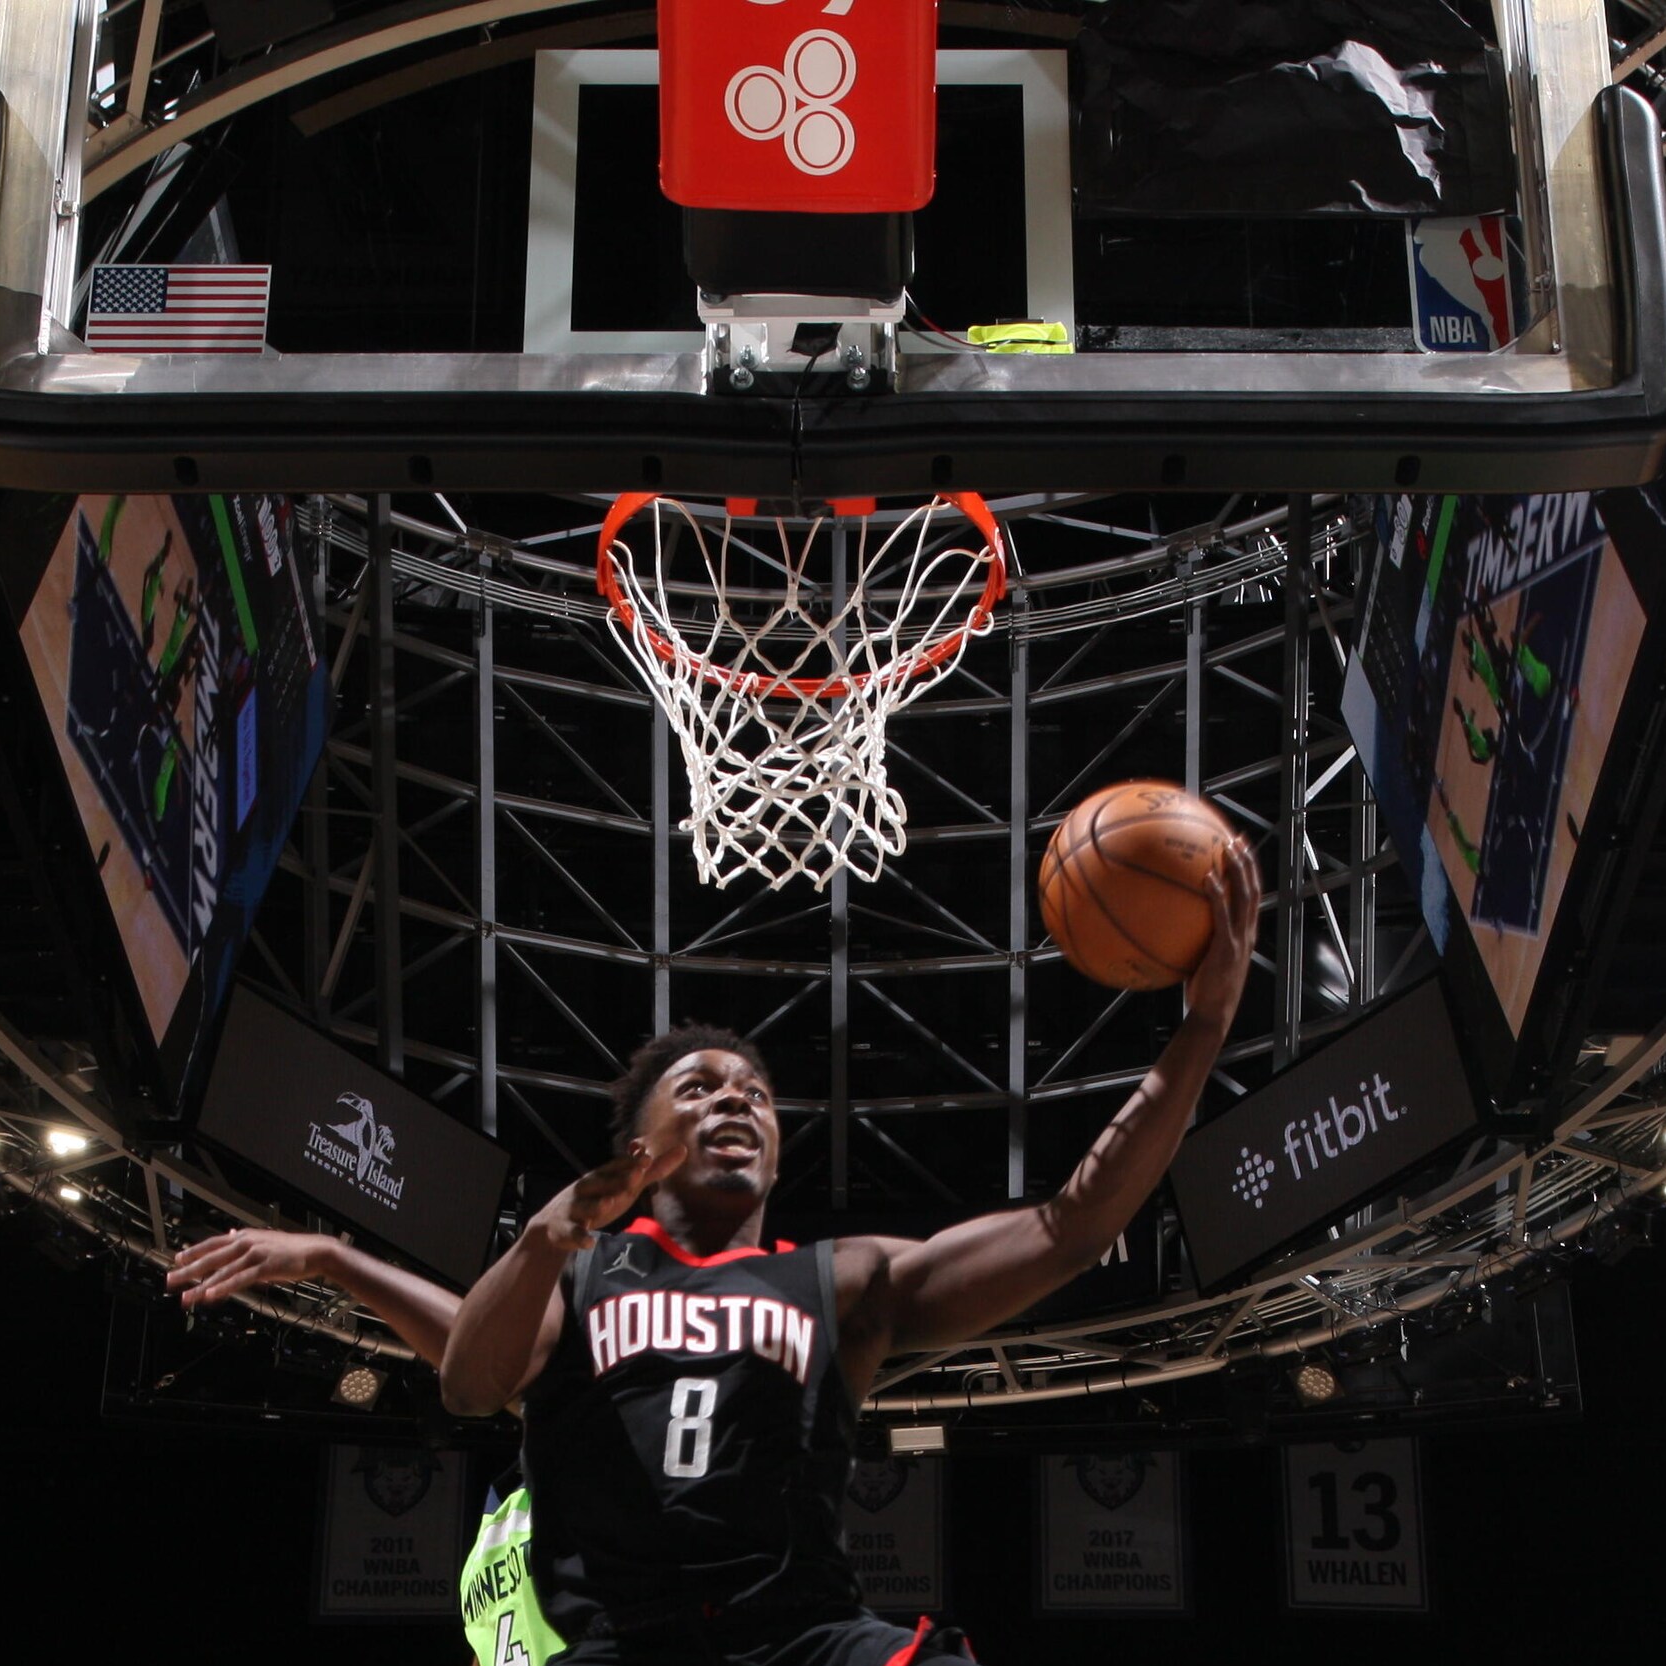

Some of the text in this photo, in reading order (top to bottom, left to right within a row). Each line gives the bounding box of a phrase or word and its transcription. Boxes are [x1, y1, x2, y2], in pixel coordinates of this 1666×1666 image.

[1429, 316, 1476, 344] NBA
[1283, 1073, 1399, 1181] fitbit
[307, 1121, 405, 1200] Treasure Island
[587, 1289, 815, 1387] HOUSTON
[663, 1377, 718, 1478] 8
[1308, 1471, 1401, 1551] 13
[370, 1536, 414, 1554] 2011
[1088, 1530, 1135, 1546] 2017
[363, 1558, 420, 1575] WNBA
[1083, 1552, 1142, 1569] WNBA
[1308, 1559, 1407, 1587] WHALEN
[334, 1579, 449, 1597] CHAMPIONS
[463, 1539, 532, 1628] MINNESOT
[1054, 1573, 1171, 1591] CHAMPIONS
